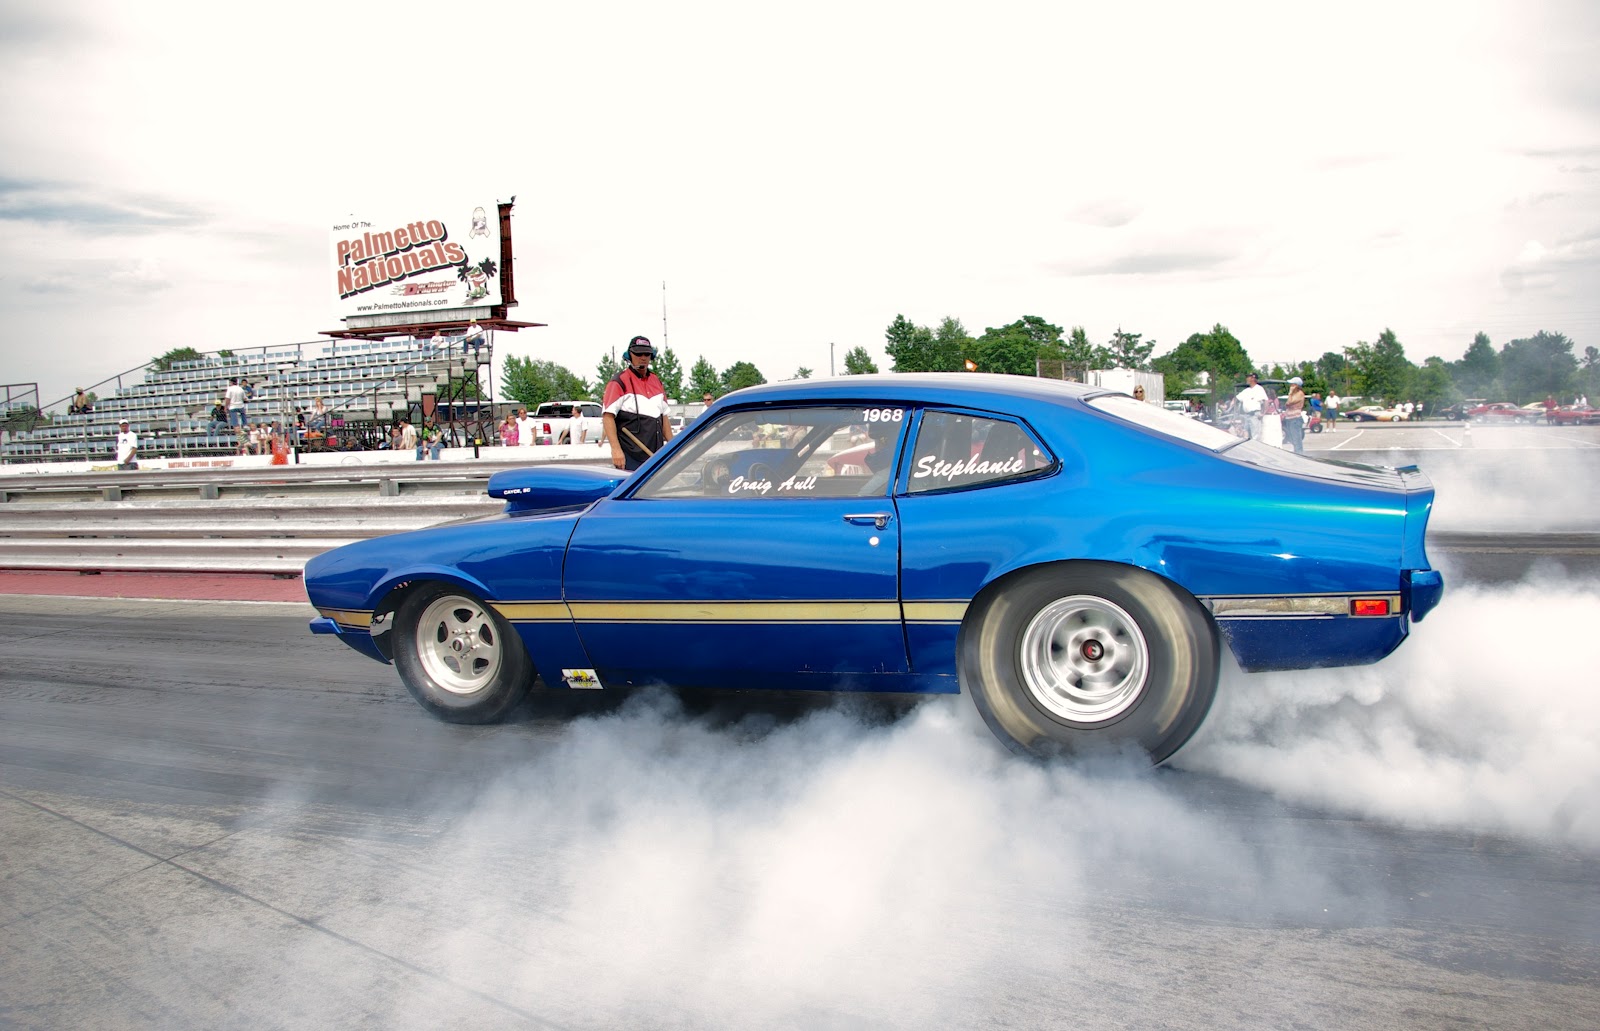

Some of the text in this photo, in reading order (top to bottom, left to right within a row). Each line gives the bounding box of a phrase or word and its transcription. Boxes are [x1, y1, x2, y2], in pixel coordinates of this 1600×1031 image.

[336, 219, 448, 267] Palmetto
[337, 241, 469, 300] Nationals
[357, 298, 449, 312] www.PalmettoNationals.com
[862, 408, 903, 422] 1968
[913, 454, 1023, 481] Stephanie
[728, 475, 817, 494] Craig Aull
